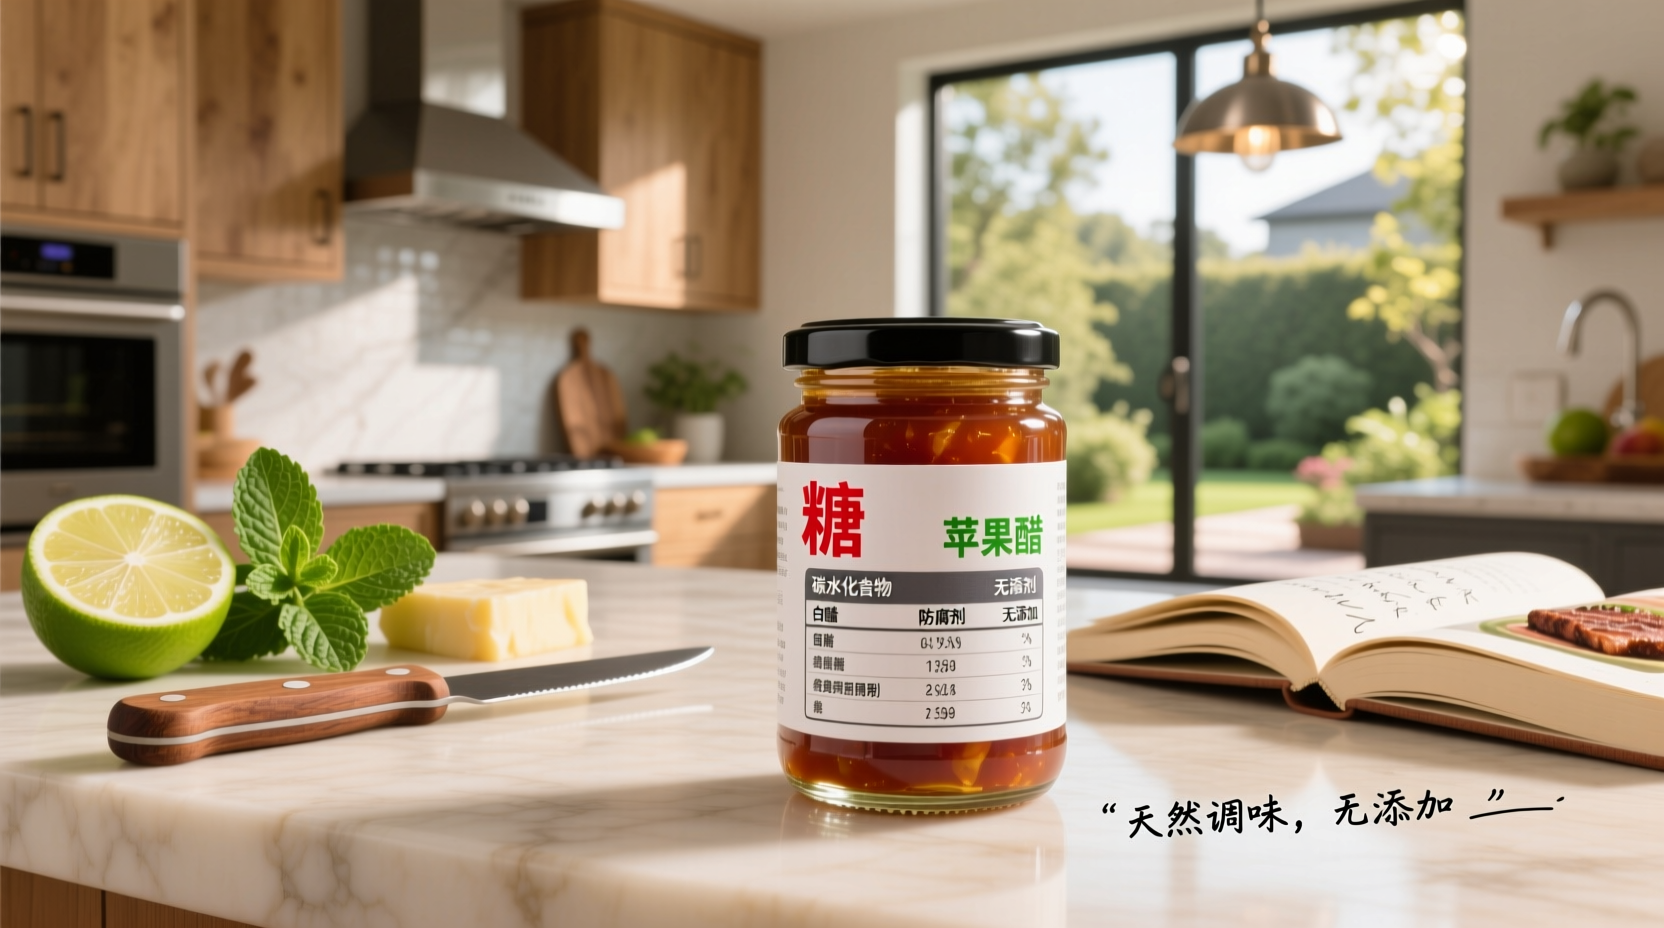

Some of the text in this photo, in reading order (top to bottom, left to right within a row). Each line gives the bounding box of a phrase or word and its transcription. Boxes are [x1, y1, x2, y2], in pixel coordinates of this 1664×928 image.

[801, 480, 865, 558] 糖
[943, 514, 1043, 558] 苹果醋
